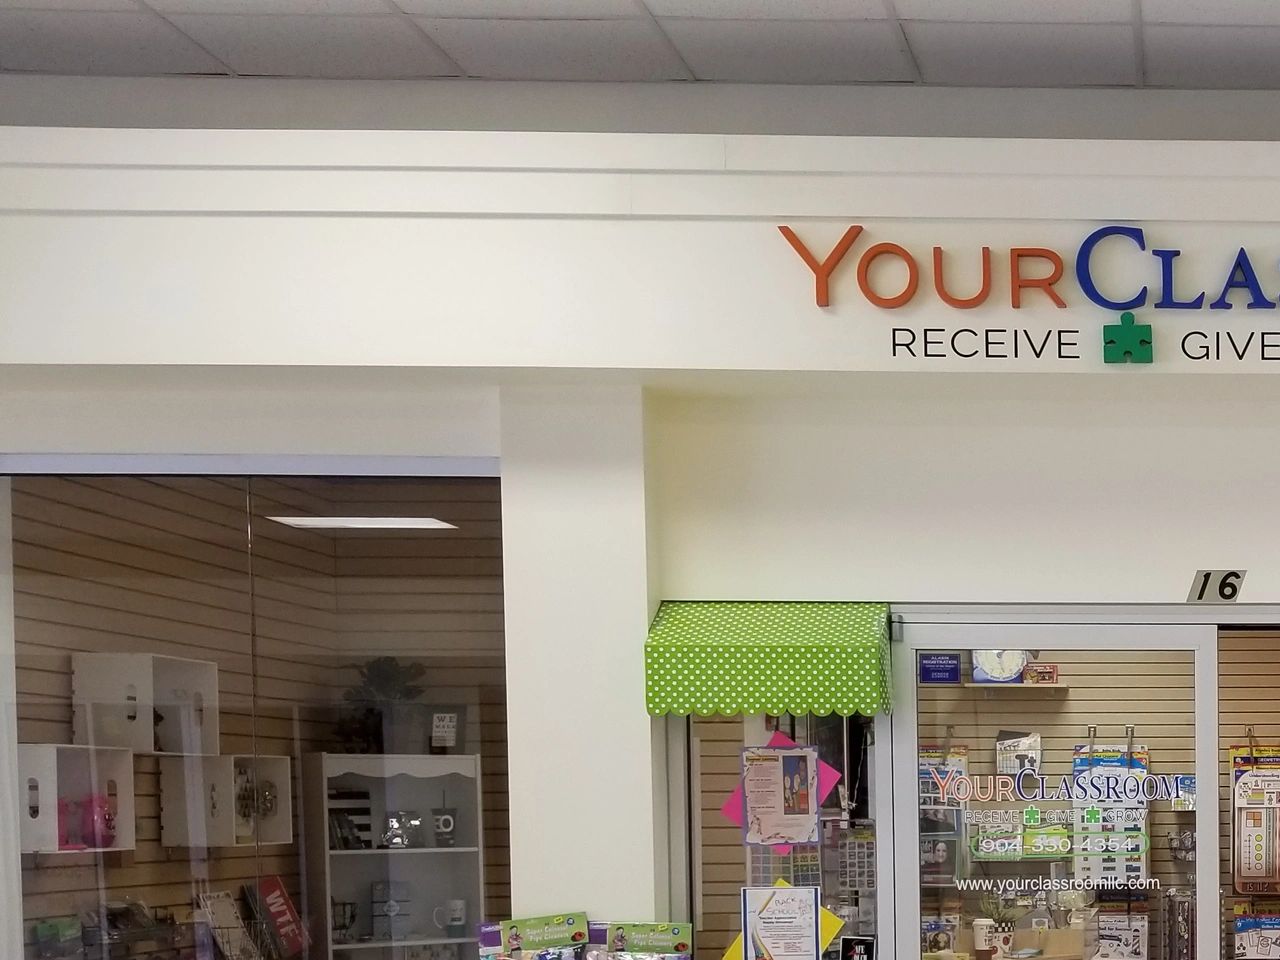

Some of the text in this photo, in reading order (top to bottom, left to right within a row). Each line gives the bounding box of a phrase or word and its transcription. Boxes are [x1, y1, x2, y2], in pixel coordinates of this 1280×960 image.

[891, 328, 1082, 361] RECEIVE
[1197, 572, 1240, 601] 16
[965, 809, 1149, 823] RECEIVE GIVE GROW
[956, 875, 1161, 892] www.yourclassroomllc.com
[265, 888, 300, 937] WTF
